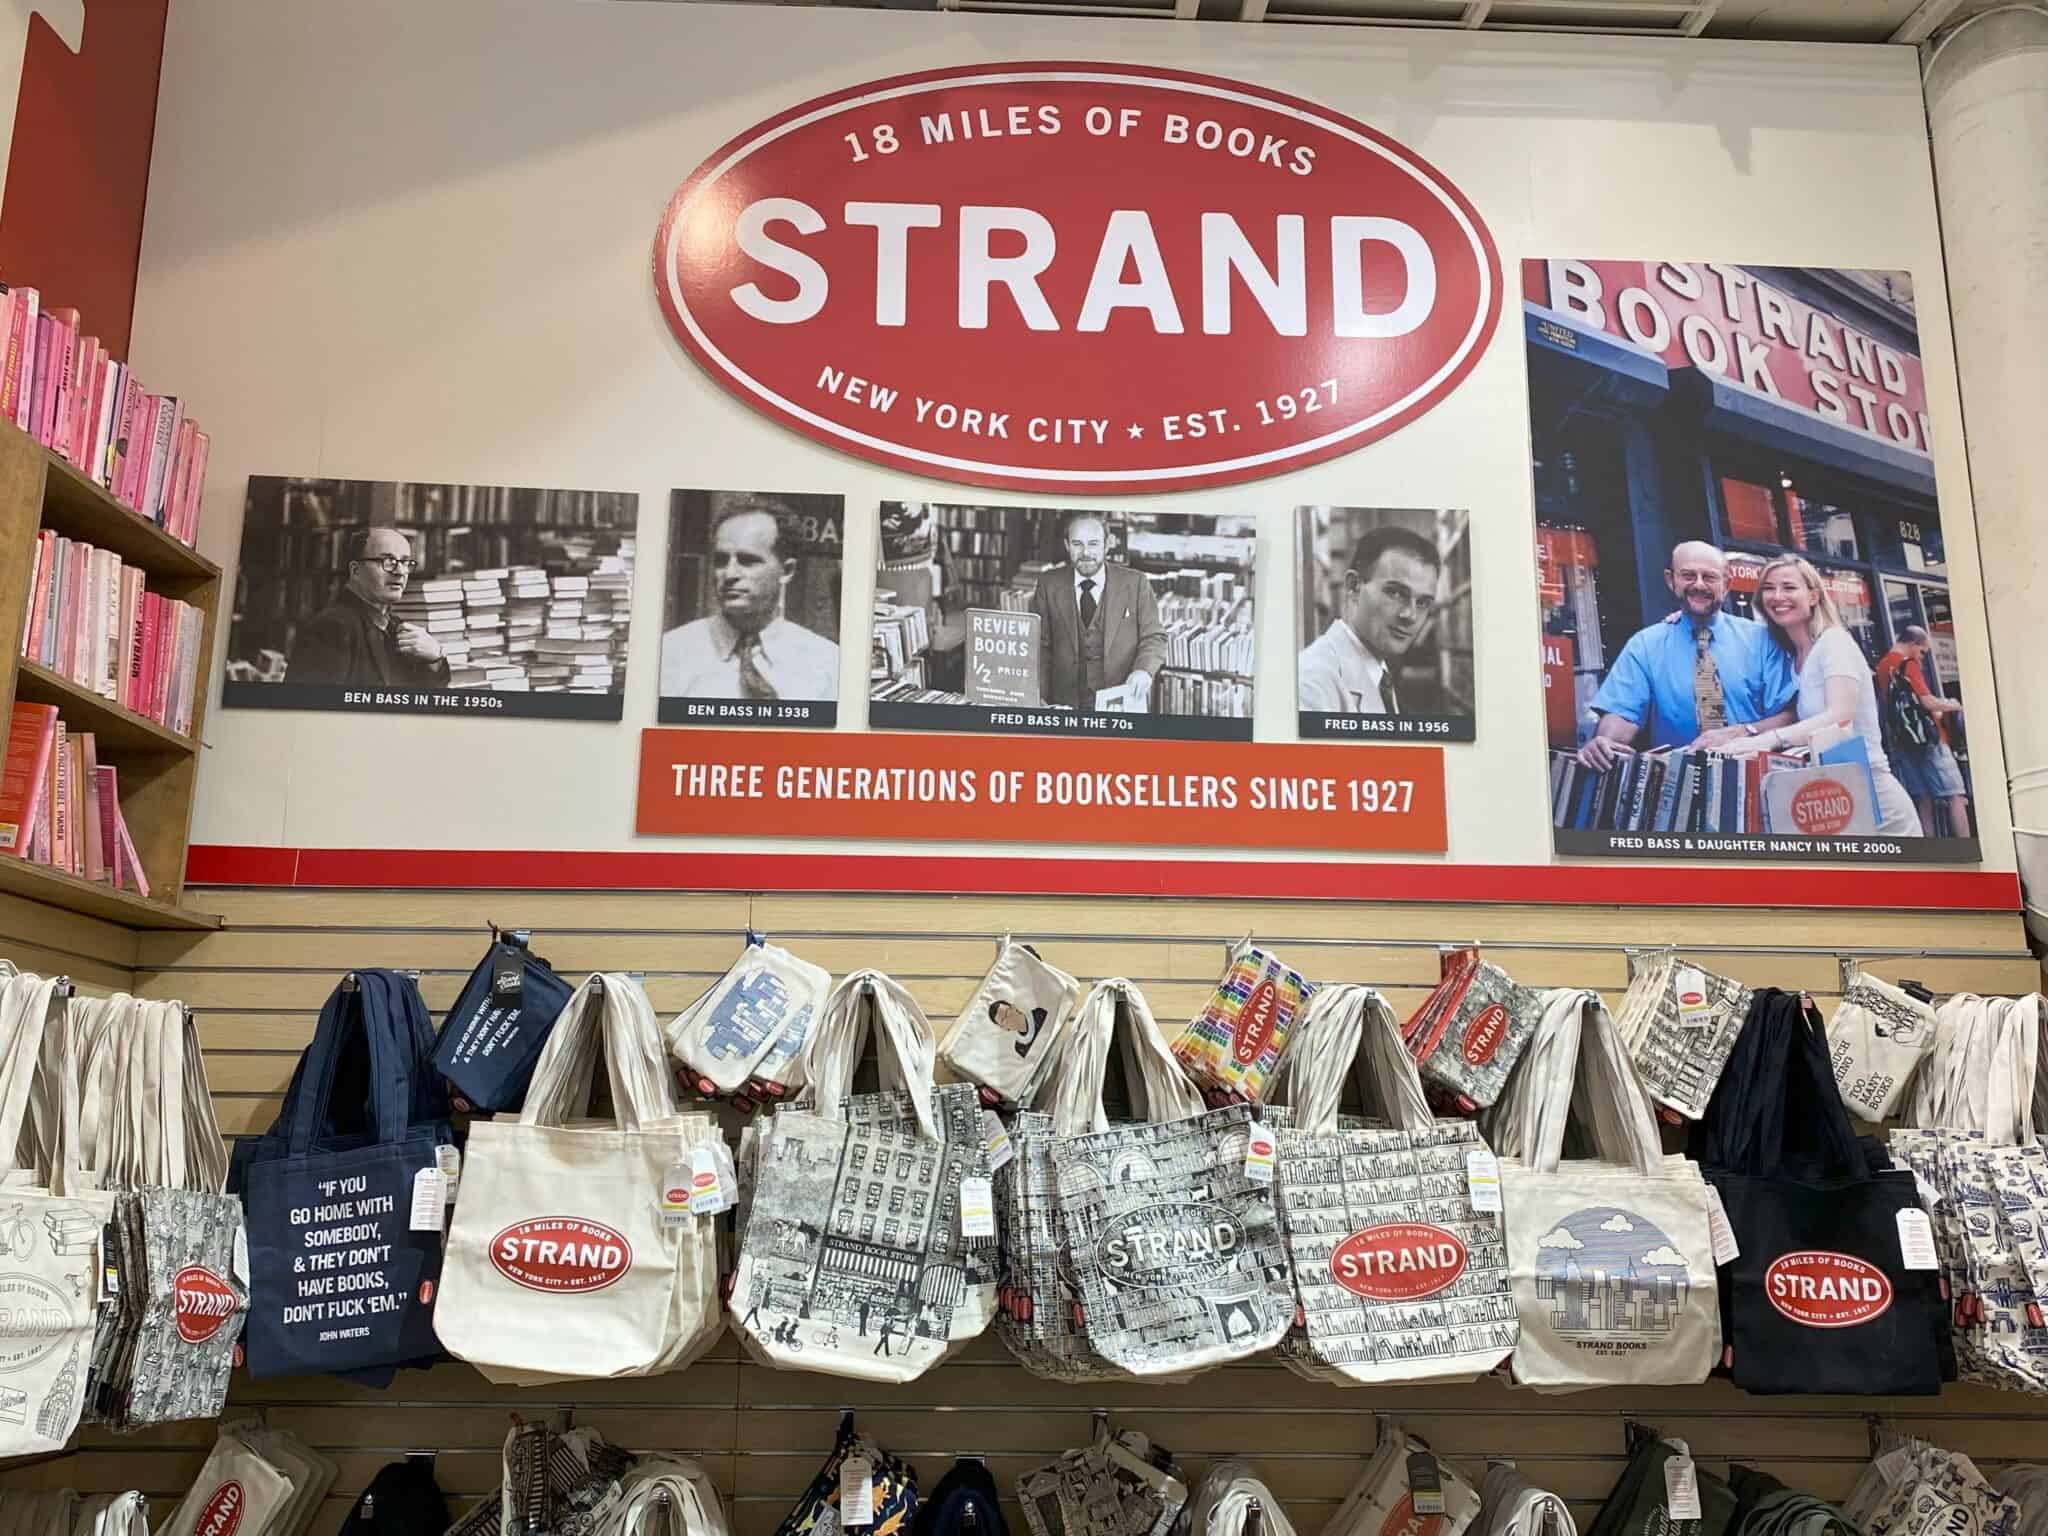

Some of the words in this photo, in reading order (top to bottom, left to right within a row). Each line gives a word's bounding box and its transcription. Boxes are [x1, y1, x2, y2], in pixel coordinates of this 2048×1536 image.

[843, 123, 899, 163] 18
[920, 105, 1062, 145] MILES
[1085, 106, 1142, 137] OF
[1163, 113, 1317, 176] BOOKS
[729, 197, 1437, 338] STRAND
[1548, 258, 1783, 402] BOOK
[1658, 261, 1906, 395] STRAND
[816, 365, 898, 413] NEW
[914, 397, 1009, 440] YORK
[1028, 418, 1110, 445] CITY
[1163, 408, 1241, 441] EST.
[1255, 378, 1340, 425] 1927
[973, 616, 1031, 637] REVIEW
[974, 636, 1029, 657] BOOKS
[997, 666, 1030, 678] PRICE
[344, 692, 371, 704] BEN
[375, 693, 410, 705] BASS
[414, 694, 429, 705] IN
[433, 695, 459, 707] THE
[463, 696, 503, 708] 1950s
[687, 705, 715, 716] BEN
[719, 705, 753, 717] BASS
[758, 706, 772, 718] IN
[777, 707, 810, 719] 1938
[990, 713, 1023, 725] FRED
[1027, 715, 1060, 726] BASS
[1064, 716, 1078, 727] IN
[1082, 718, 1107, 729] THE
[1112, 718, 1133, 730] 70s
[1325, 719, 1358, 730] FRED
[1362, 720, 1395, 731] BASS
[1399, 721, 1413, 732] IN
[1418, 722, 1450, 733] 1956
[671, 763, 764, 798] THREE
[776, 766, 977, 802] GENERATIONS
[989, 770, 1025, 803] OF
[1036, 772, 1238, 809] BOOKSELLERS
[1249, 777, 1337, 811] SINCE
[1347, 780, 1414, 813] 1927
[1796, 796, 1851, 825] STRAND
[1609, 837, 1643, 849] FRED
[1647, 838, 1680, 849] BASS
[1684, 839, 1693, 849] &
[1697, 839, 1766, 851] DAUGHTER
[1770, 841, 1812, 852] NANCY
[1816, 842, 1830, 853] IN
[1834, 842, 1860, 854] THE
[1863, 843, 1902, 855] 2000s
[1239, 985, 1274, 1060] STRAND
[1467, 1008, 1504, 1062] STRAND
[1849, 1077, 1866, 1100] TOO
[1858, 1072, 1883, 1106] MANY
[1868, 1075, 1895, 1111] BOOKS
[339, 1175, 366, 1195] YOU
[290, 1207, 311, 1225] GO
[314, 1202, 354, 1223] HOME
[355, 1195, 394, 1216] WITH
[304, 1222, 381, 1248] SOMEBODY,
[534, 1221, 563, 1232] MILES
[566, 1222, 579, 1231] OF
[500, 1236, 622, 1270] STRAND
[1106, 1222, 1237, 1268] STRAND
[293, 1256, 306, 1273] &
[309, 1250, 347, 1271] THEY
[348, 1245, 392, 1266] DON'T
[1340, 1243, 1458, 1278] STRAND
[1790, 1256, 1815, 1266] MILES
[1817, 1257, 1830, 1265] OF
[1833, 1258, 1866, 1274] BOOKS
[297, 1277, 334, 1297] HAVE
[337, 1270, 389, 1293] BOOKS,
[1773, 1272, 1883, 1302] STRAND
[283, 1303, 325, 1324] DON'T
[327, 1298, 365, 1319] FUCK
[319, 1330, 338, 1342] JOHN
[339, 1326, 370, 1340] WATERS
[1575, 1341, 1613, 1350] STRAND
[1615, 1342, 1648, 1350] BOOKS
